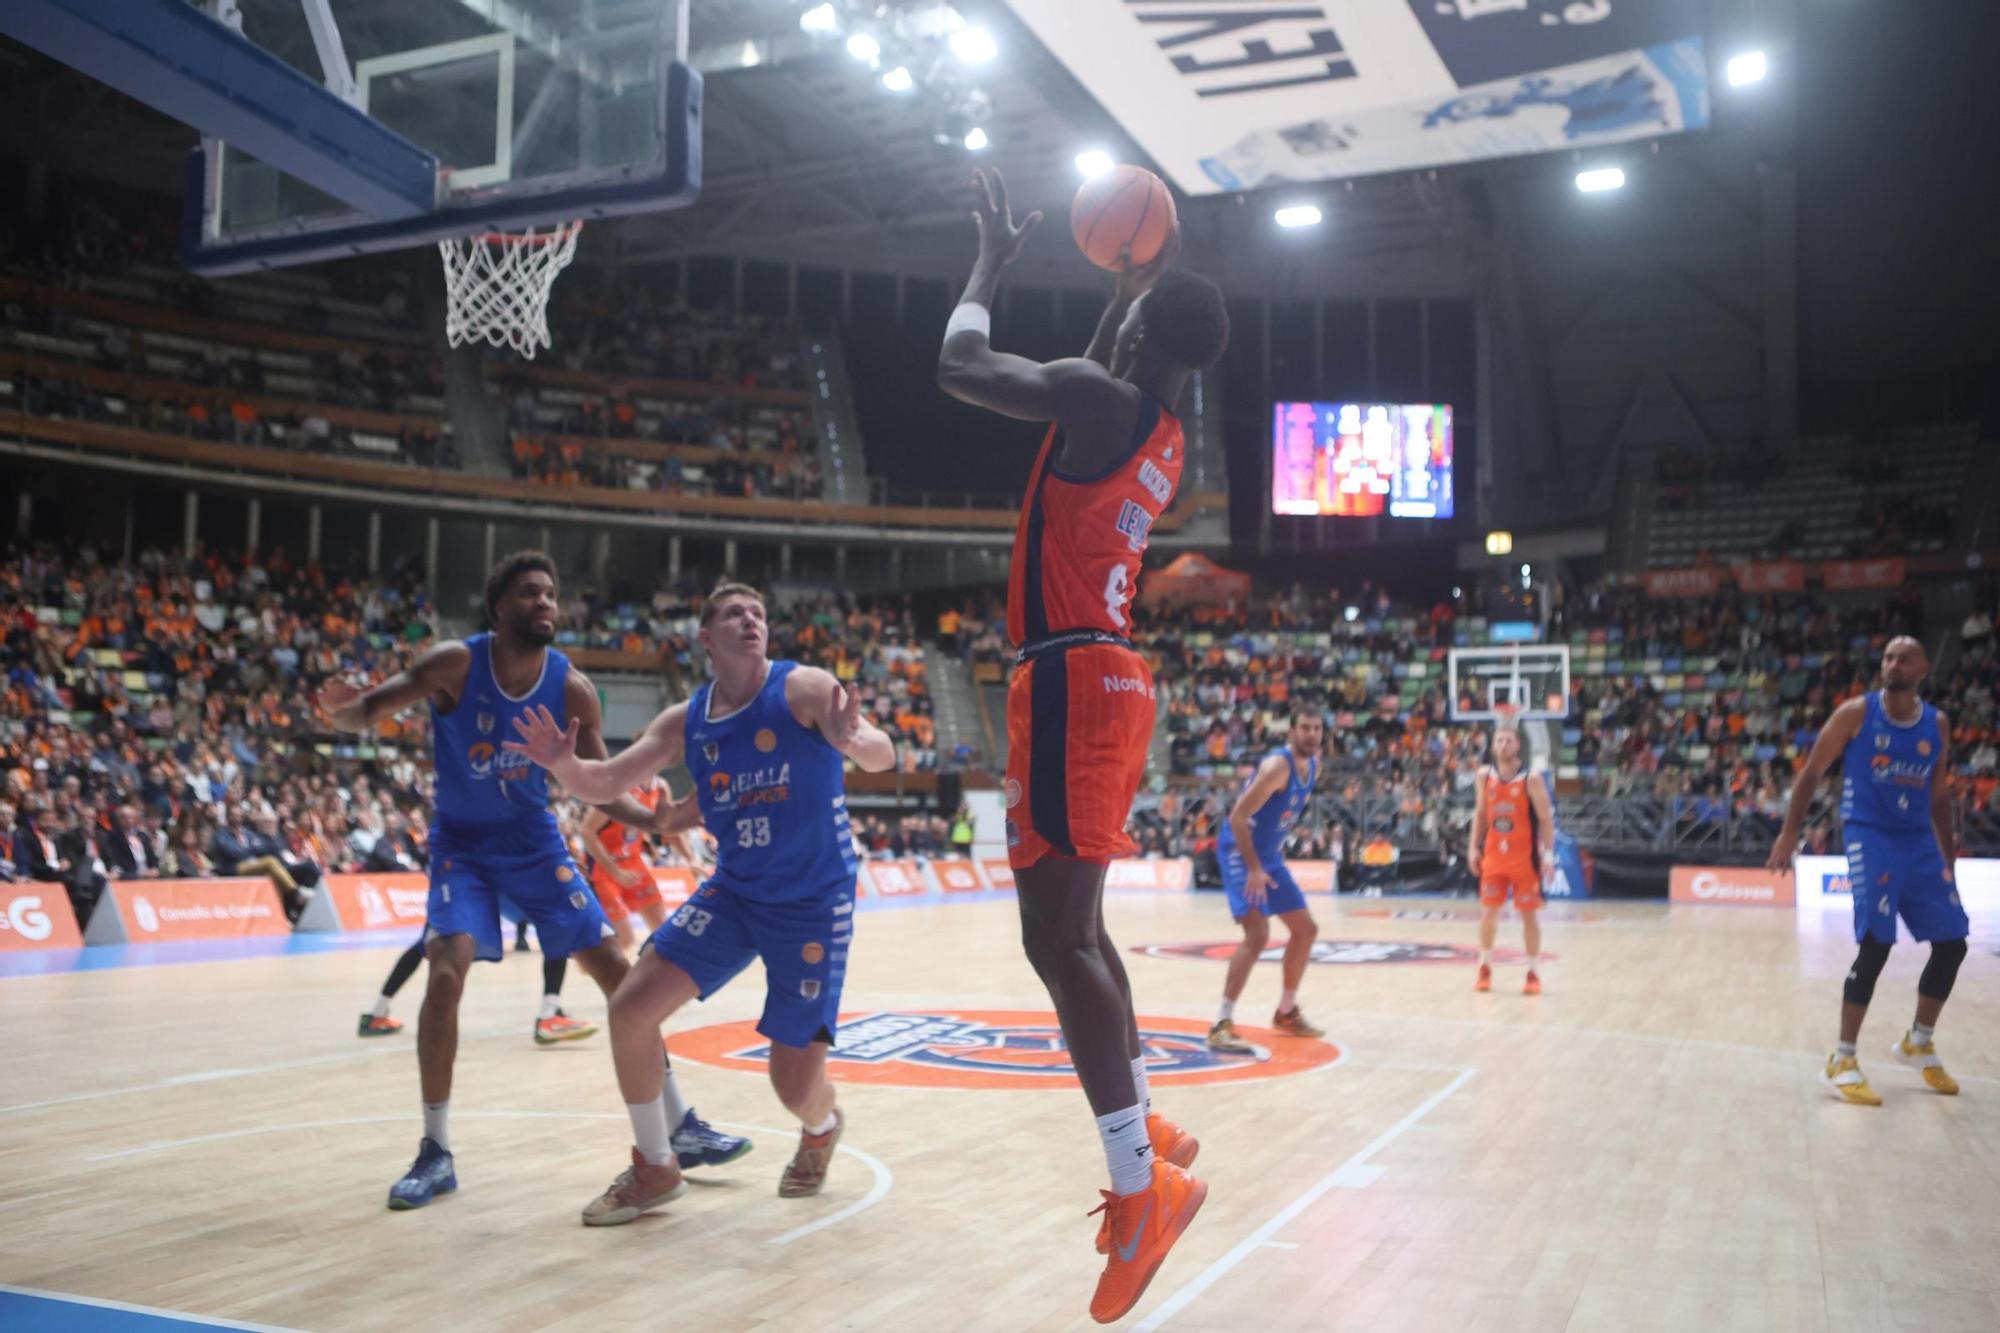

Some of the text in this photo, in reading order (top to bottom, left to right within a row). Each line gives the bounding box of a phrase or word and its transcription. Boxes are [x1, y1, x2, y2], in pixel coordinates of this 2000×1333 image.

[1123, 0, 1359, 98] LEY
[736, 816, 771, 848] 33
[671, 904, 713, 937] 33
